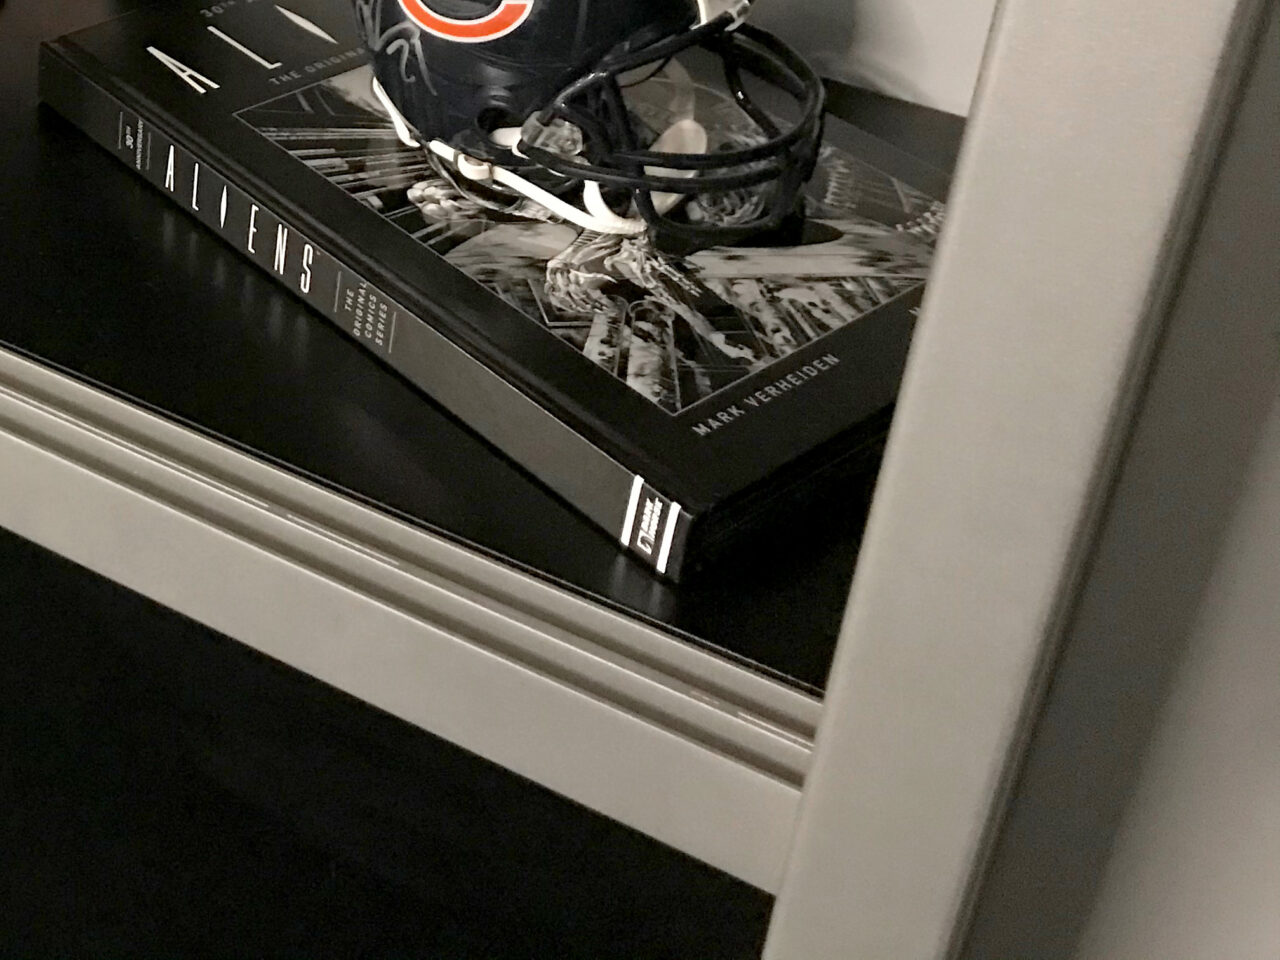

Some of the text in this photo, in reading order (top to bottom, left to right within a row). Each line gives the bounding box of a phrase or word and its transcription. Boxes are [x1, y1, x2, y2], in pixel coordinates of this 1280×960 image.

[268, 46, 367, 86] THE ORIGINA
[164, 144, 313, 294] ALIENS
[344, 289, 355, 312] THE
[353, 281, 368, 337] ORIGINAL
[364, 294, 377, 339] COMICS
[375, 302, 388, 346] SERIES
[692, 352, 841, 437] MARK VERHEIDEN
